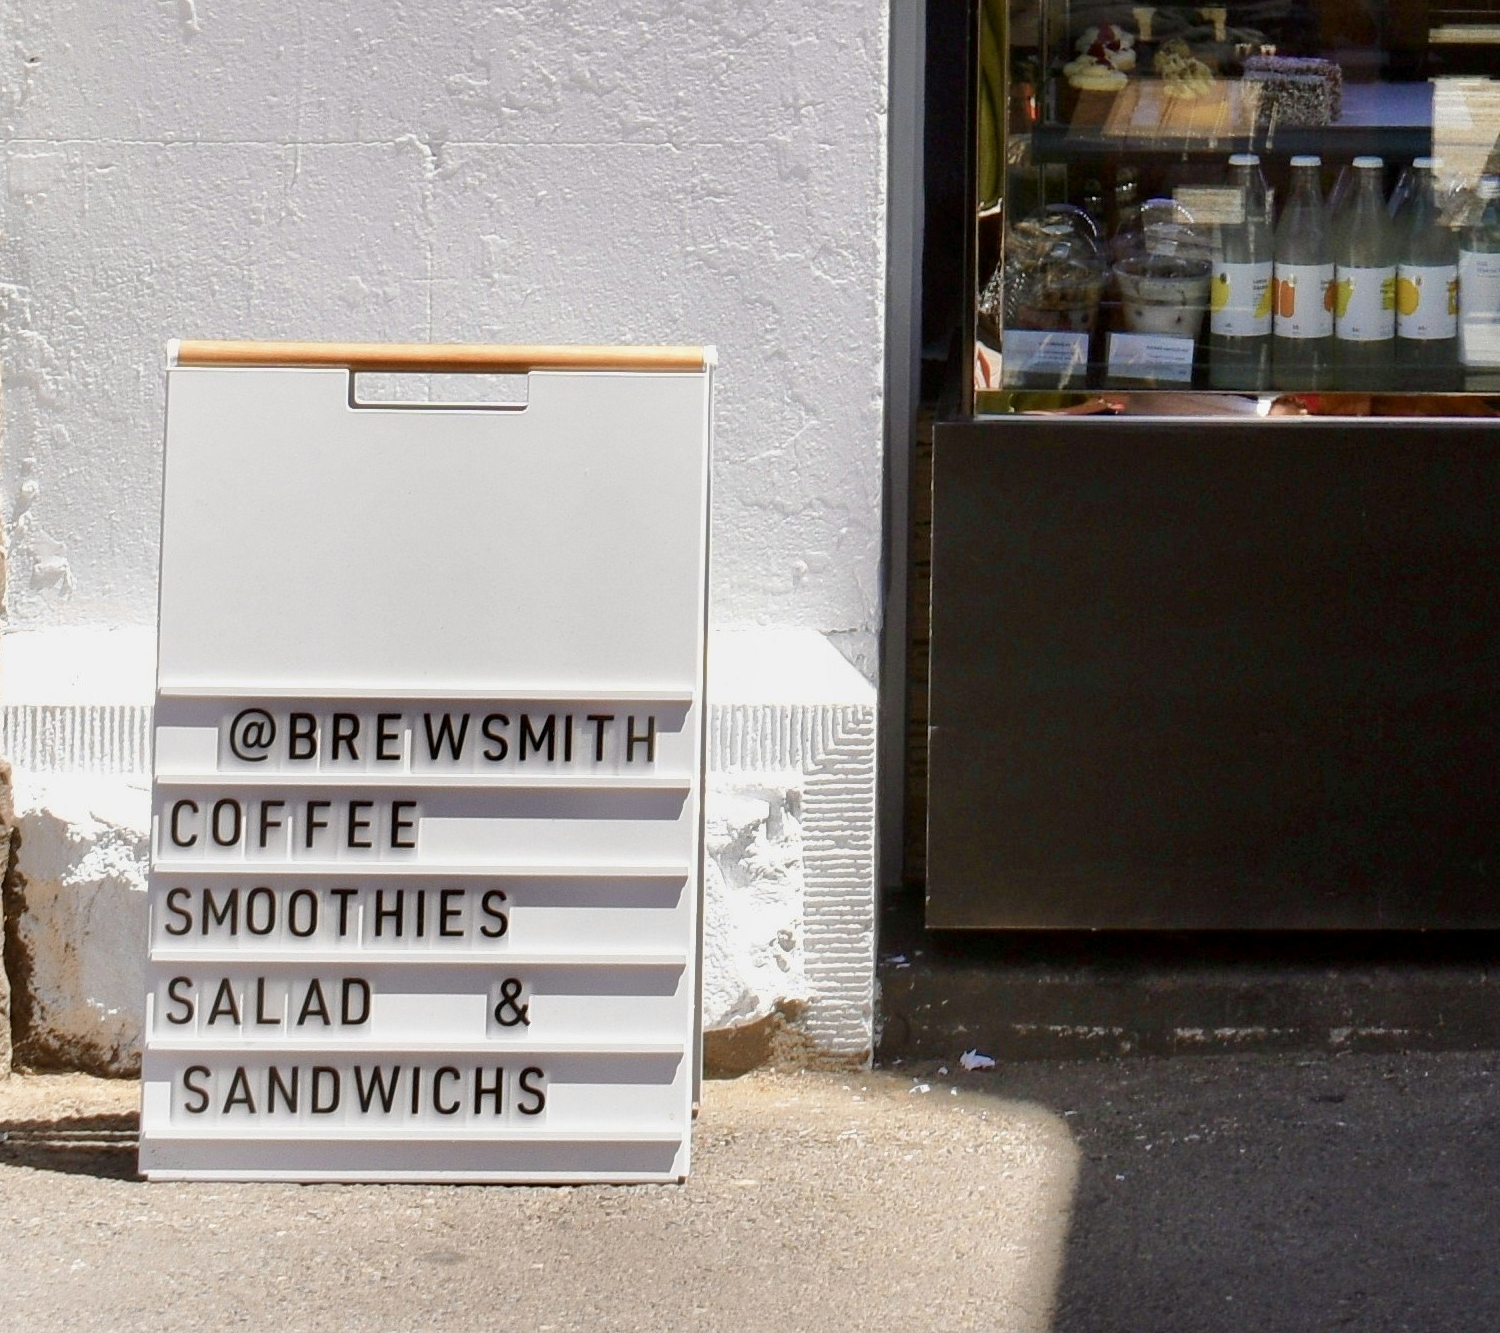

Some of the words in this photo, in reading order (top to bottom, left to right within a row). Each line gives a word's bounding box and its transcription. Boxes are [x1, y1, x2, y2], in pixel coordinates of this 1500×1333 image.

[229, 707, 657, 764] @BREWSMITH
[169, 798, 418, 849] COFFEE
[164, 887, 510, 938] SMOOTHIES
[166, 976, 372, 1026] SALAD
[494, 976, 532, 1028] &
[182, 1064, 548, 1116] SANDWICHS
